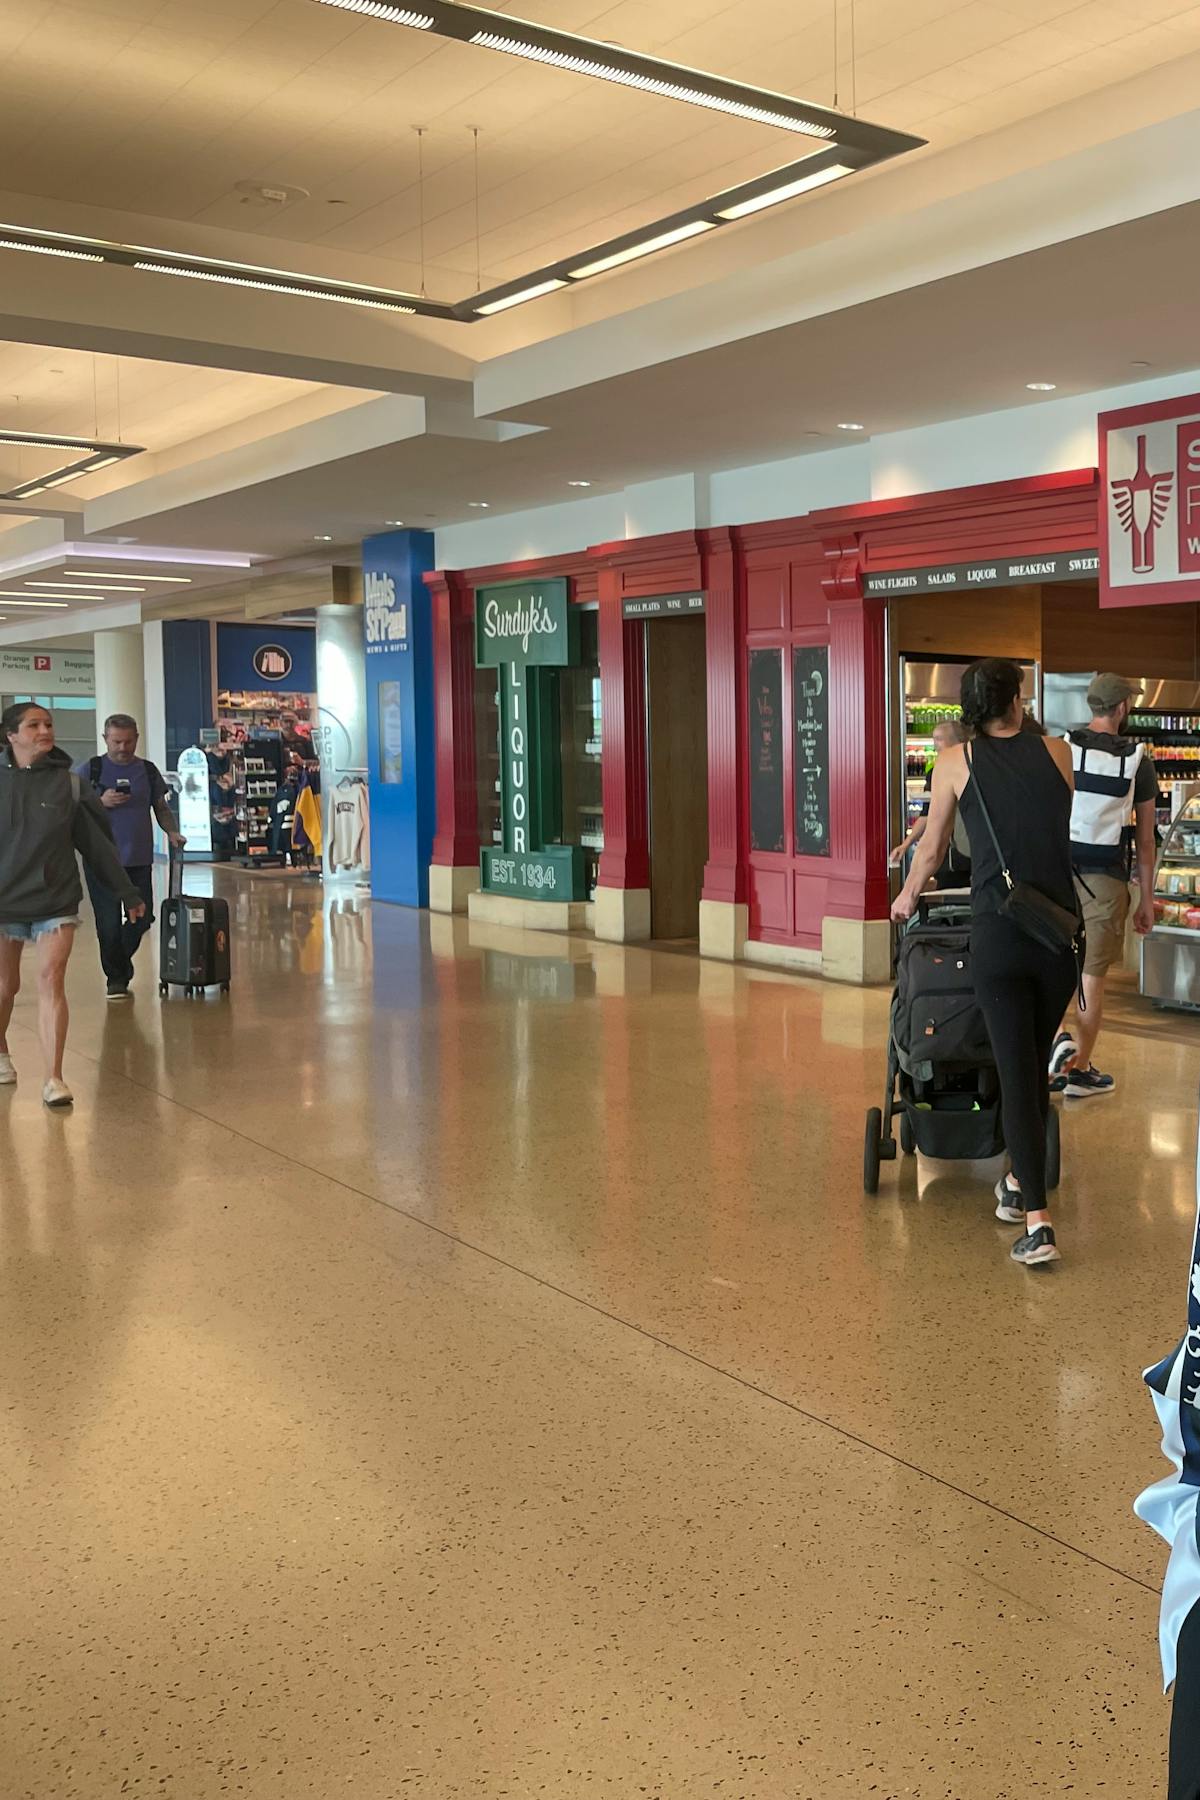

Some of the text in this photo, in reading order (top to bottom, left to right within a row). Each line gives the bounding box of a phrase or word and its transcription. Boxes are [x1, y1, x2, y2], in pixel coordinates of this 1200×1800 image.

[868, 579, 887, 590] WINE
[887, 575, 918, 590] FLIGHTS
[927, 572, 956, 586] SALADS
[967, 568, 997, 582] LIQUOR
[1008, 561, 1057, 577] BREAKFAST
[642, 601, 660, 612] PLATES
[667, 599, 681, 609] WINE
[688, 597, 703, 608] BEER
[484, 595, 558, 654] Surdyk's
[390, 643, 407, 652] GIFTS
[2, 663, 30, 671] Parking
[3, 655, 30, 663] Orange
[511, 660, 526, 854] LIQUOR
[491, 858, 556, 889] EST. 1934
